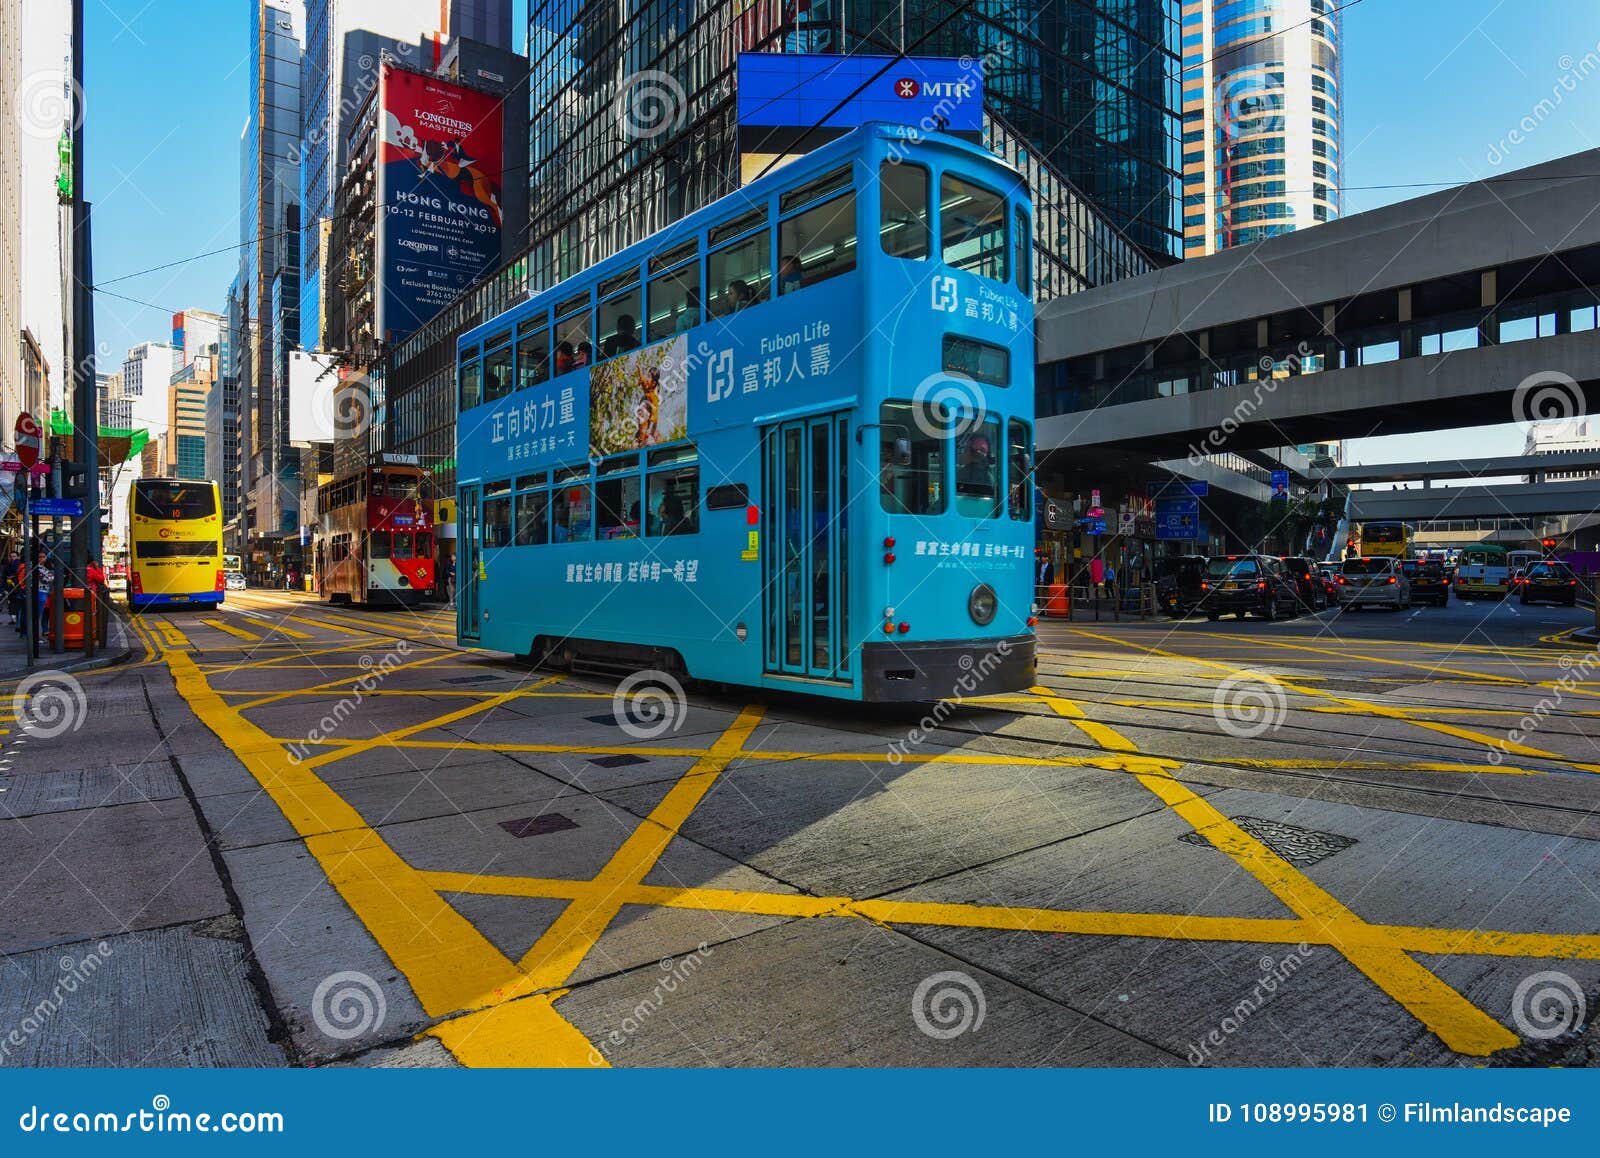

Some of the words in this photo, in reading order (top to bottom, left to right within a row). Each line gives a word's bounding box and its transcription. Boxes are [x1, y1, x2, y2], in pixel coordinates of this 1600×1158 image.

[923, 82, 971, 98] MTR
[415, 109, 473, 132] LONGINES
[420, 121, 467, 137] MASTERS
[396, 190, 441, 209] HONG
[448, 201, 489, 219] KONG
[386, 205, 415, 218] 10-12
[419, 212, 470, 229] FEBRUARY
[474, 223, 497, 234] 2017
[398, 239, 439, 252] LONGINES
[401, 279, 430, 289] Exclusive
[431, 284, 456, 294] Booking
[761, 332, 800, 355] Fubon
[804, 320, 830, 343] Life
[742, 343, 831, 394] 富邦人壽
[492, 387, 575, 443] 正向的力量
[391, 455, 410, 463] 107
[566, 562, 622, 583] 豐富生命價值
[628, 559, 699, 583] 延伸每一希望
